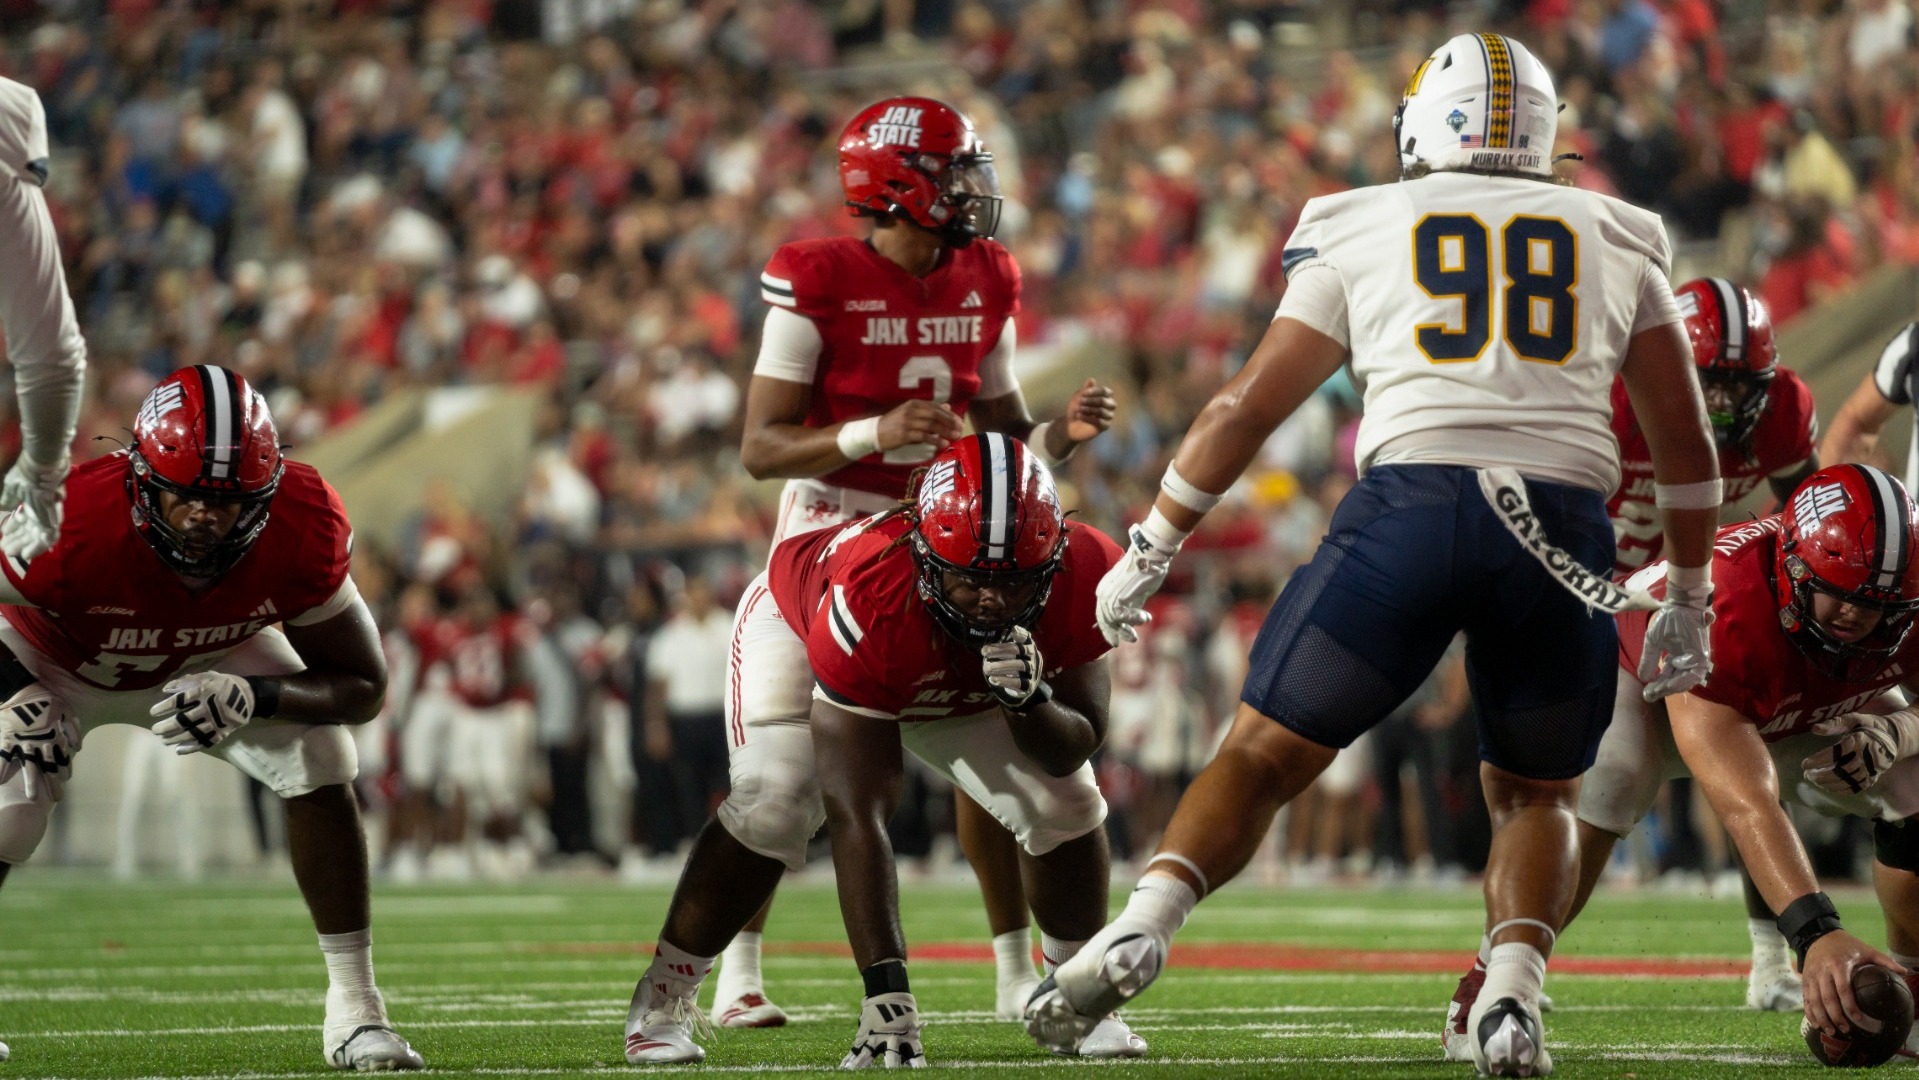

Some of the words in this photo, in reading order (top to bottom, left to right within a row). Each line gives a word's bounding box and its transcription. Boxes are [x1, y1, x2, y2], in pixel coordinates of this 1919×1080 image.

[878, 107, 924, 125] JAX
[866, 125, 923, 148] STATE
[1518, 134, 1529, 149] 98
[1471, 152, 1514, 167] MURRAY
[1517, 154, 1541, 168] STATE
[1411, 212, 1579, 366] 98
[861, 318, 909, 346] JAX
[917, 316, 983, 346] STATE
[932, 460, 956, 501] JAX
[1794, 486, 1821, 540] STATE
[1813, 483, 1847, 520] JAX
[100, 627, 164, 650] JAX
[173, 618, 266, 648] STATE
